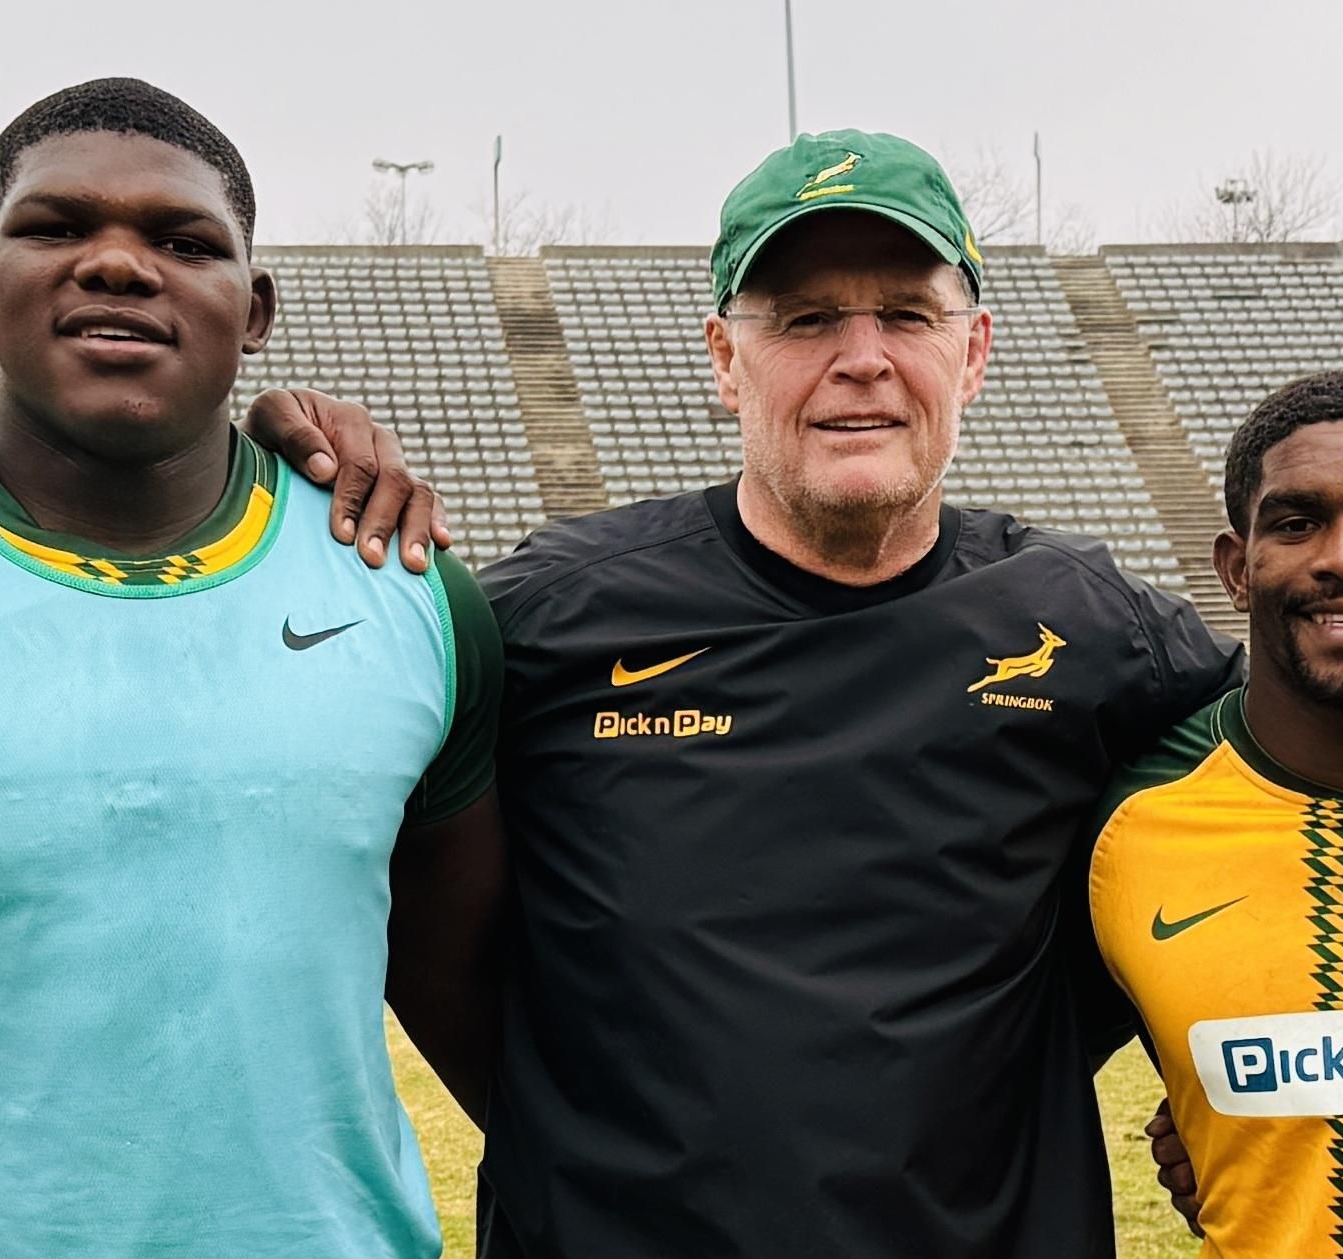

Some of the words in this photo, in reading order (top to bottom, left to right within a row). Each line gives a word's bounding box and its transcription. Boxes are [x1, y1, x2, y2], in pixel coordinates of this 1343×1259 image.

[981, 692, 1054, 711] SPRINGBOK
[594, 711, 652, 738] Pick
[654, 716, 670, 735] n
[673, 709, 732, 737] Pay
